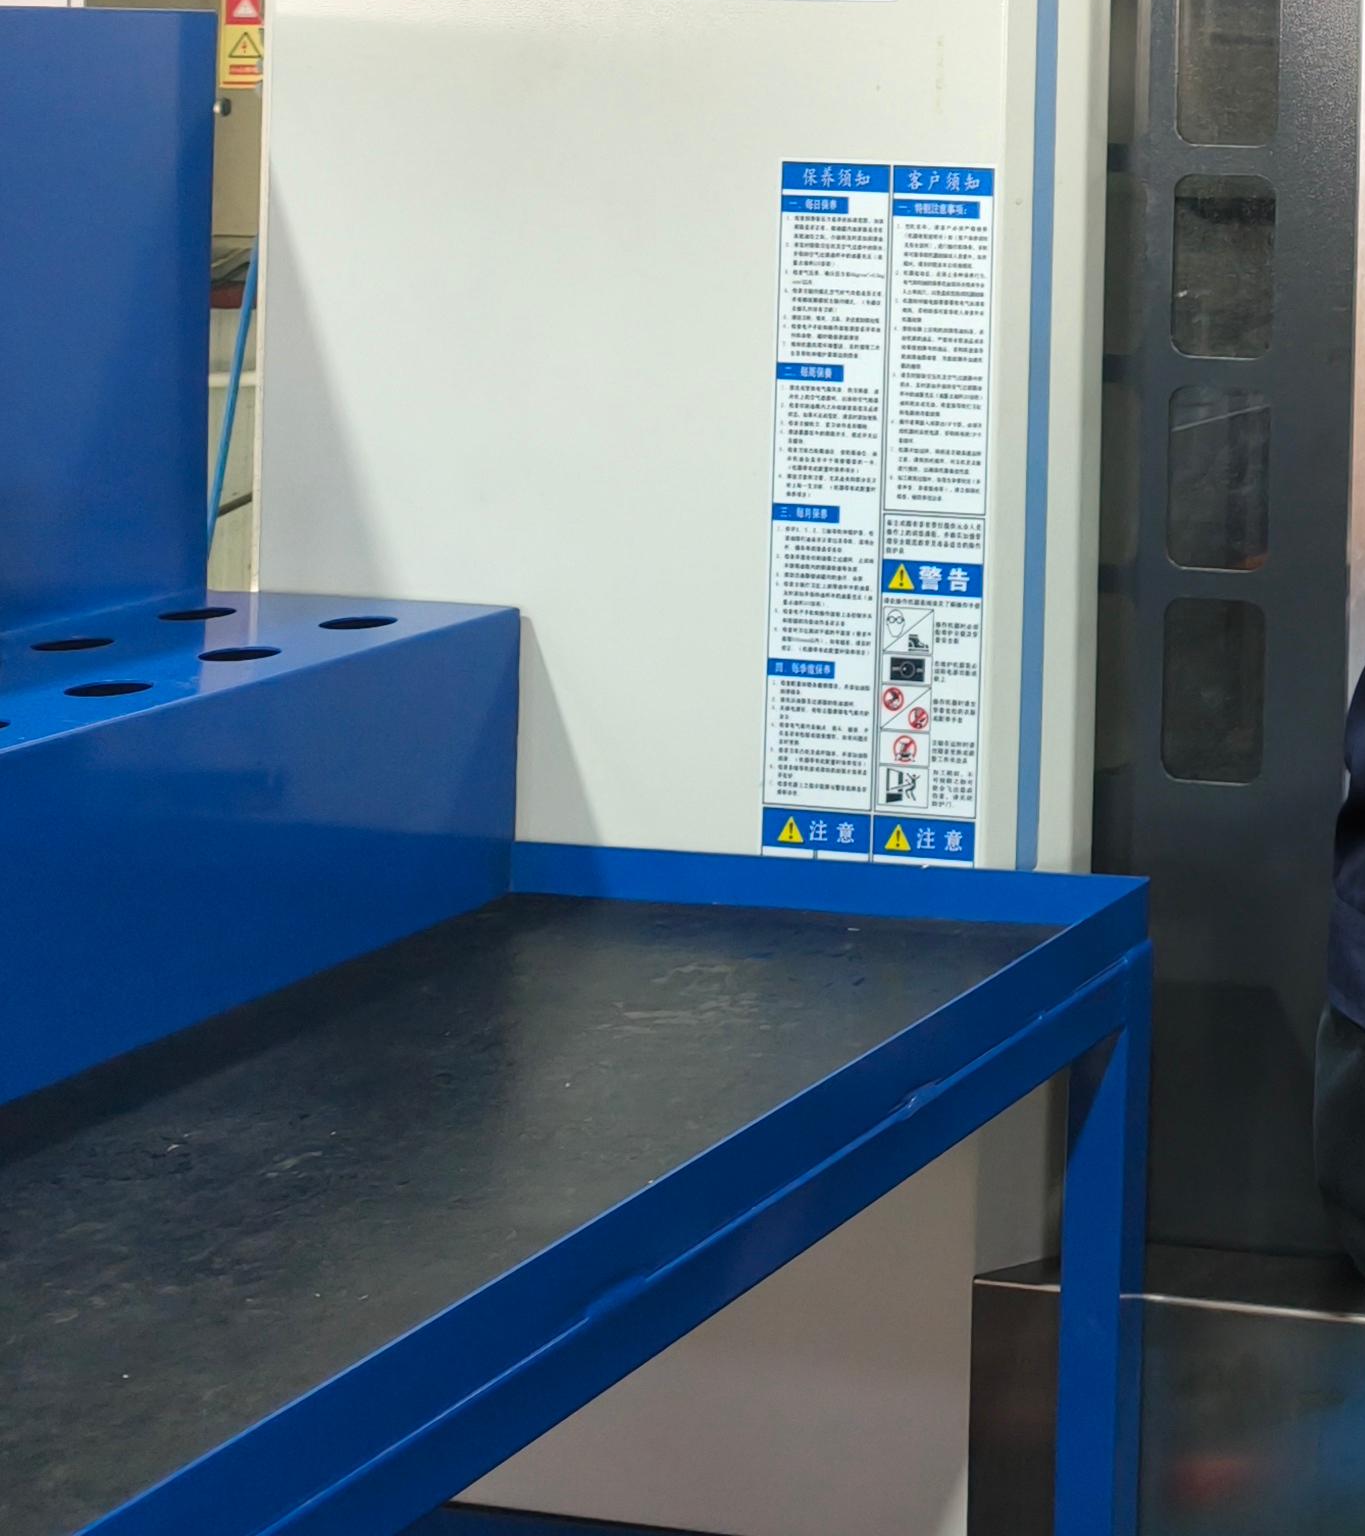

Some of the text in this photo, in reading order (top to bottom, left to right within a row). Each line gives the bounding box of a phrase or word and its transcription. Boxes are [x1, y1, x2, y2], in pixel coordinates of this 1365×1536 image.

[802, 166, 871, 188] 保养须知
[908, 169, 980, 192] 客户须知
[918, 565, 971, 592] 警告
[809, 820, 855, 844] 注意
[916, 827, 963, 852] 注意
